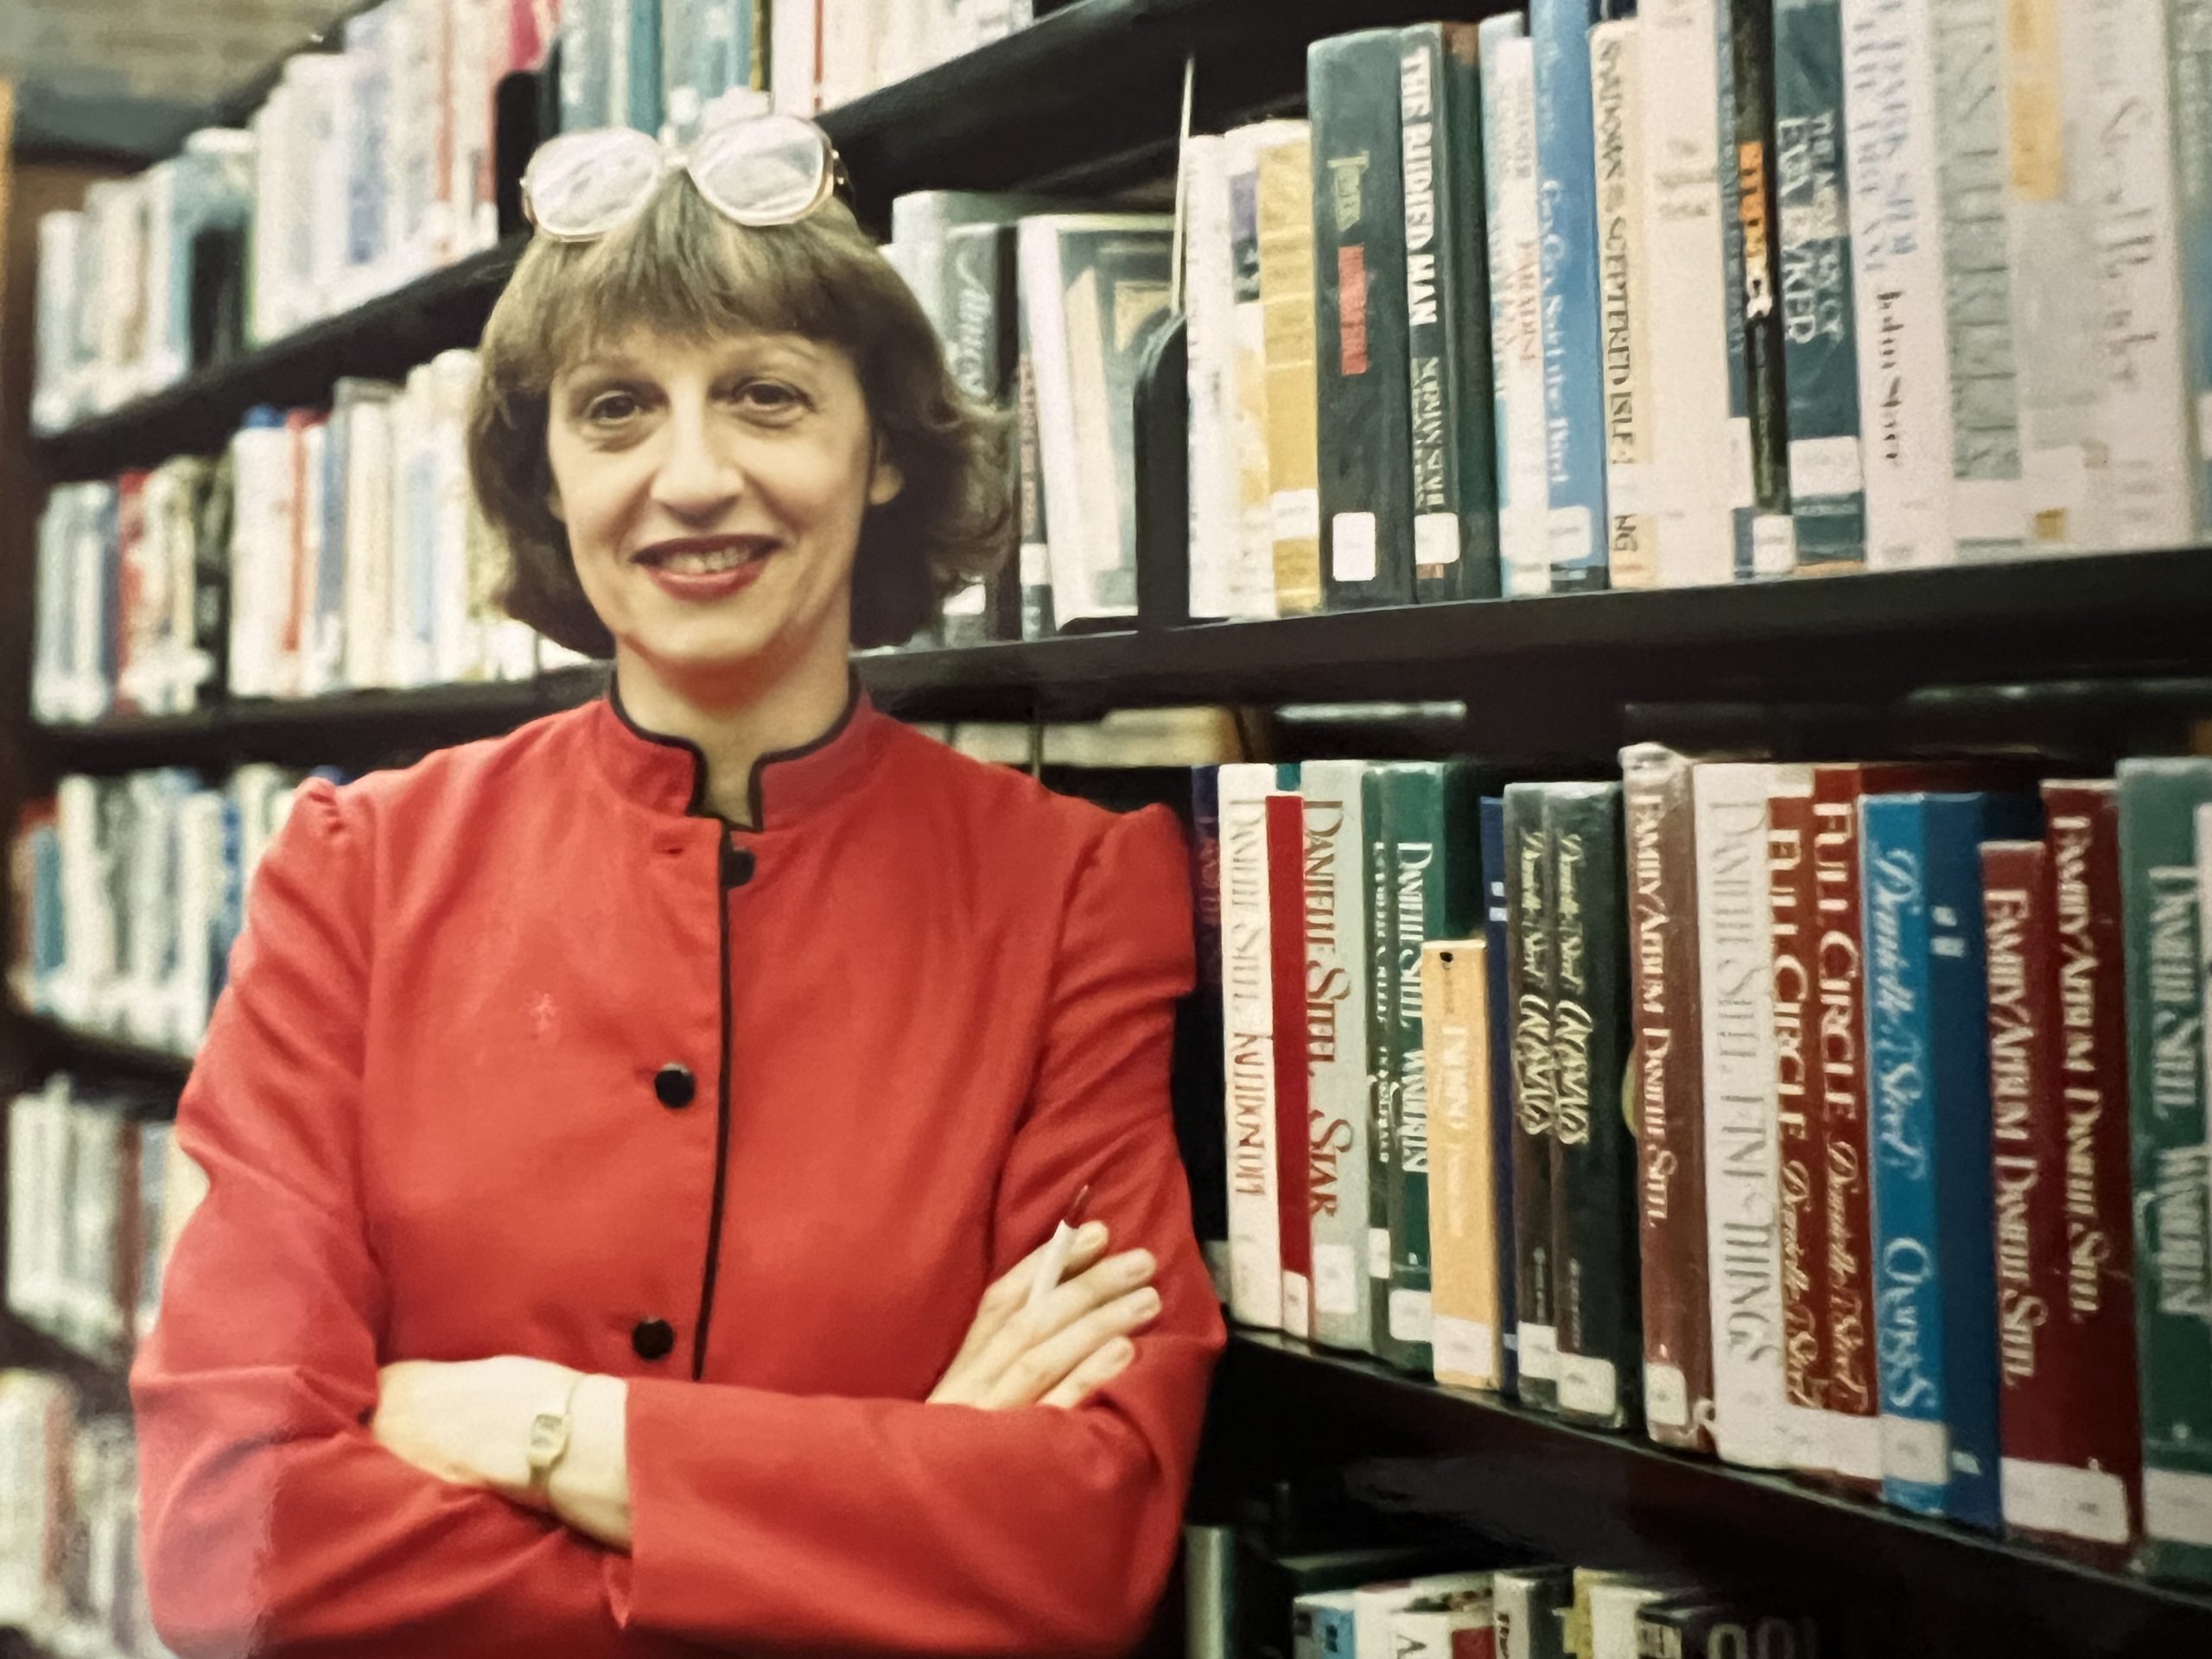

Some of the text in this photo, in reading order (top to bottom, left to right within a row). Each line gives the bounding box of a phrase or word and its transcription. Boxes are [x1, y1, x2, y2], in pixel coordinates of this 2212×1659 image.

[1407, 254, 1439, 326] MAN
[1397, 842, 1433, 943] DANIELLE
[1710, 802, 1769, 948] DANIELLE
[1768, 828, 1811, 938] FULL
[1815, 801, 1855, 912] FULL
[1302, 800, 1356, 1219] DANIELLE STEEL STAR
[1631, 793, 1676, 1228] FAMILY ALBUM DANIELLE STEEL
[1719, 957, 1772, 1074] STEEL
[1771, 954, 1808, 1141] CIRCLE
[1817, 930, 1859, 1122] CIRCLE
[2053, 815, 2109, 1325] FAMILY ALBUM DANIELLE STEEL
[1984, 888, 2049, 1387] FAMILY ALBUM DANIELLE STEEL
[1725, 1220, 1777, 1363] THINGS
